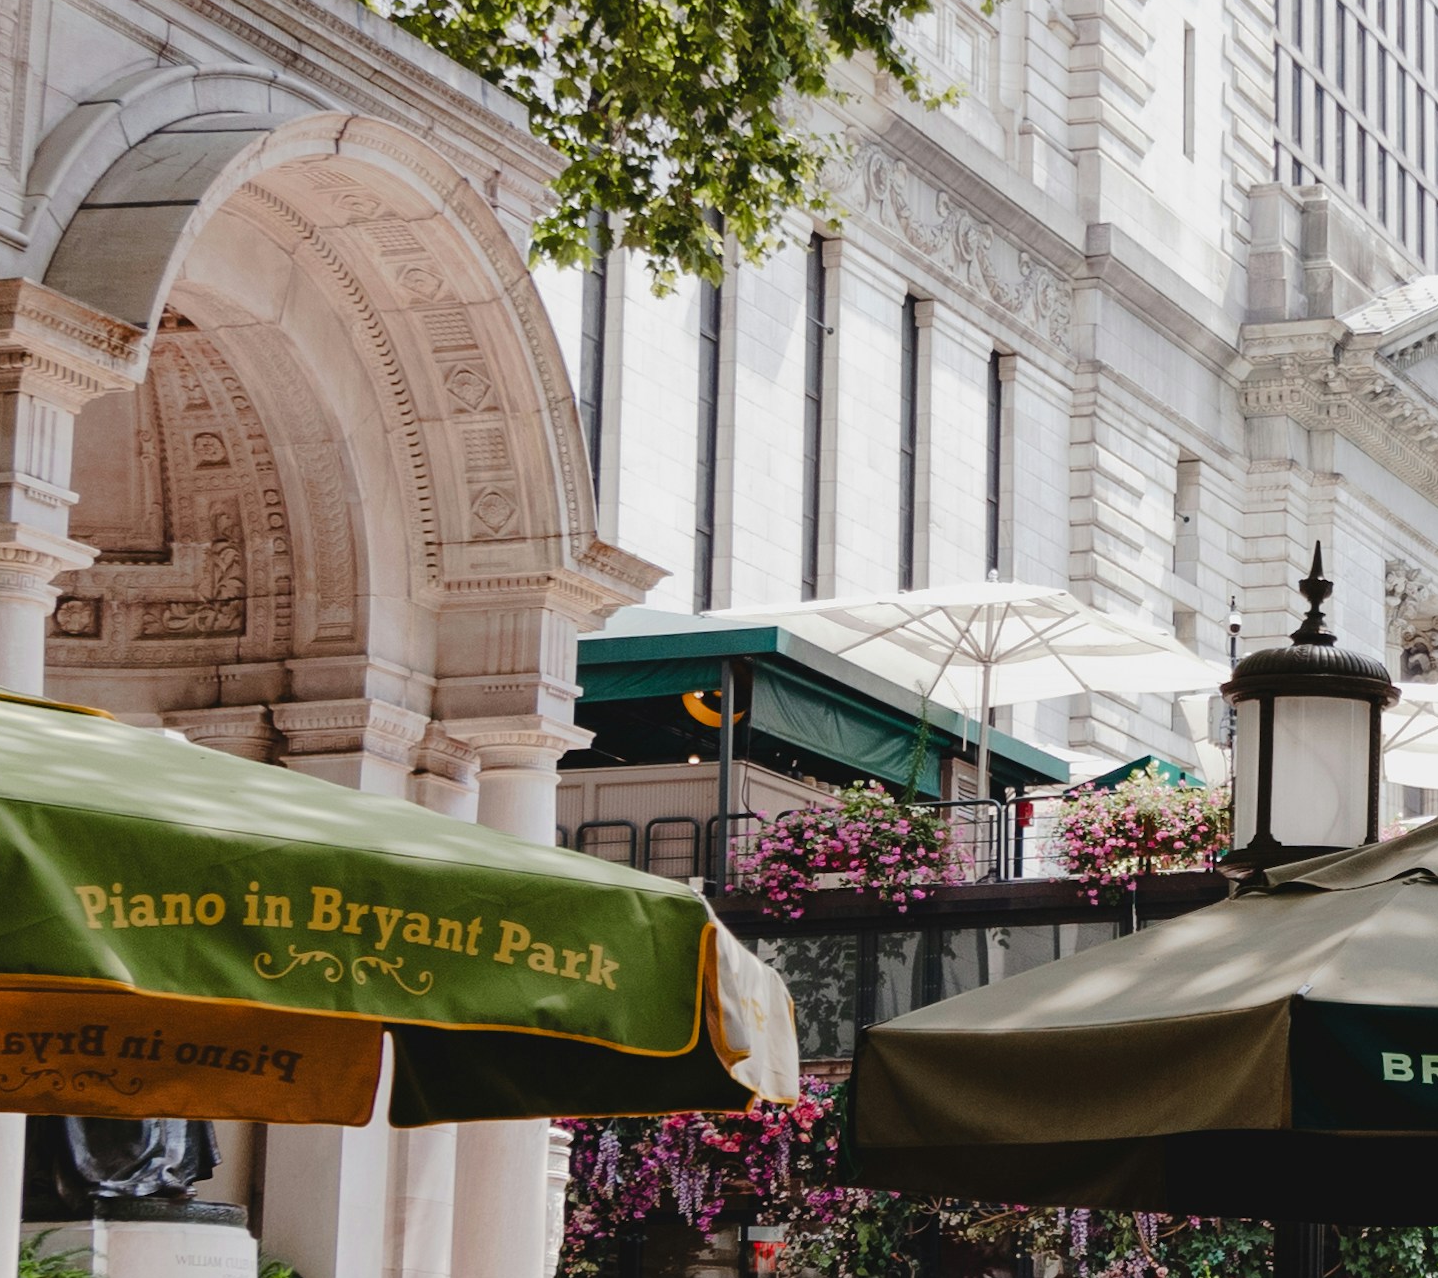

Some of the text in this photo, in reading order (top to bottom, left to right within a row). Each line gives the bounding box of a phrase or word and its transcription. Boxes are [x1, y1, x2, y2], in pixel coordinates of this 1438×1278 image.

[74, 881, 619, 990] Piano in Bryant Park
